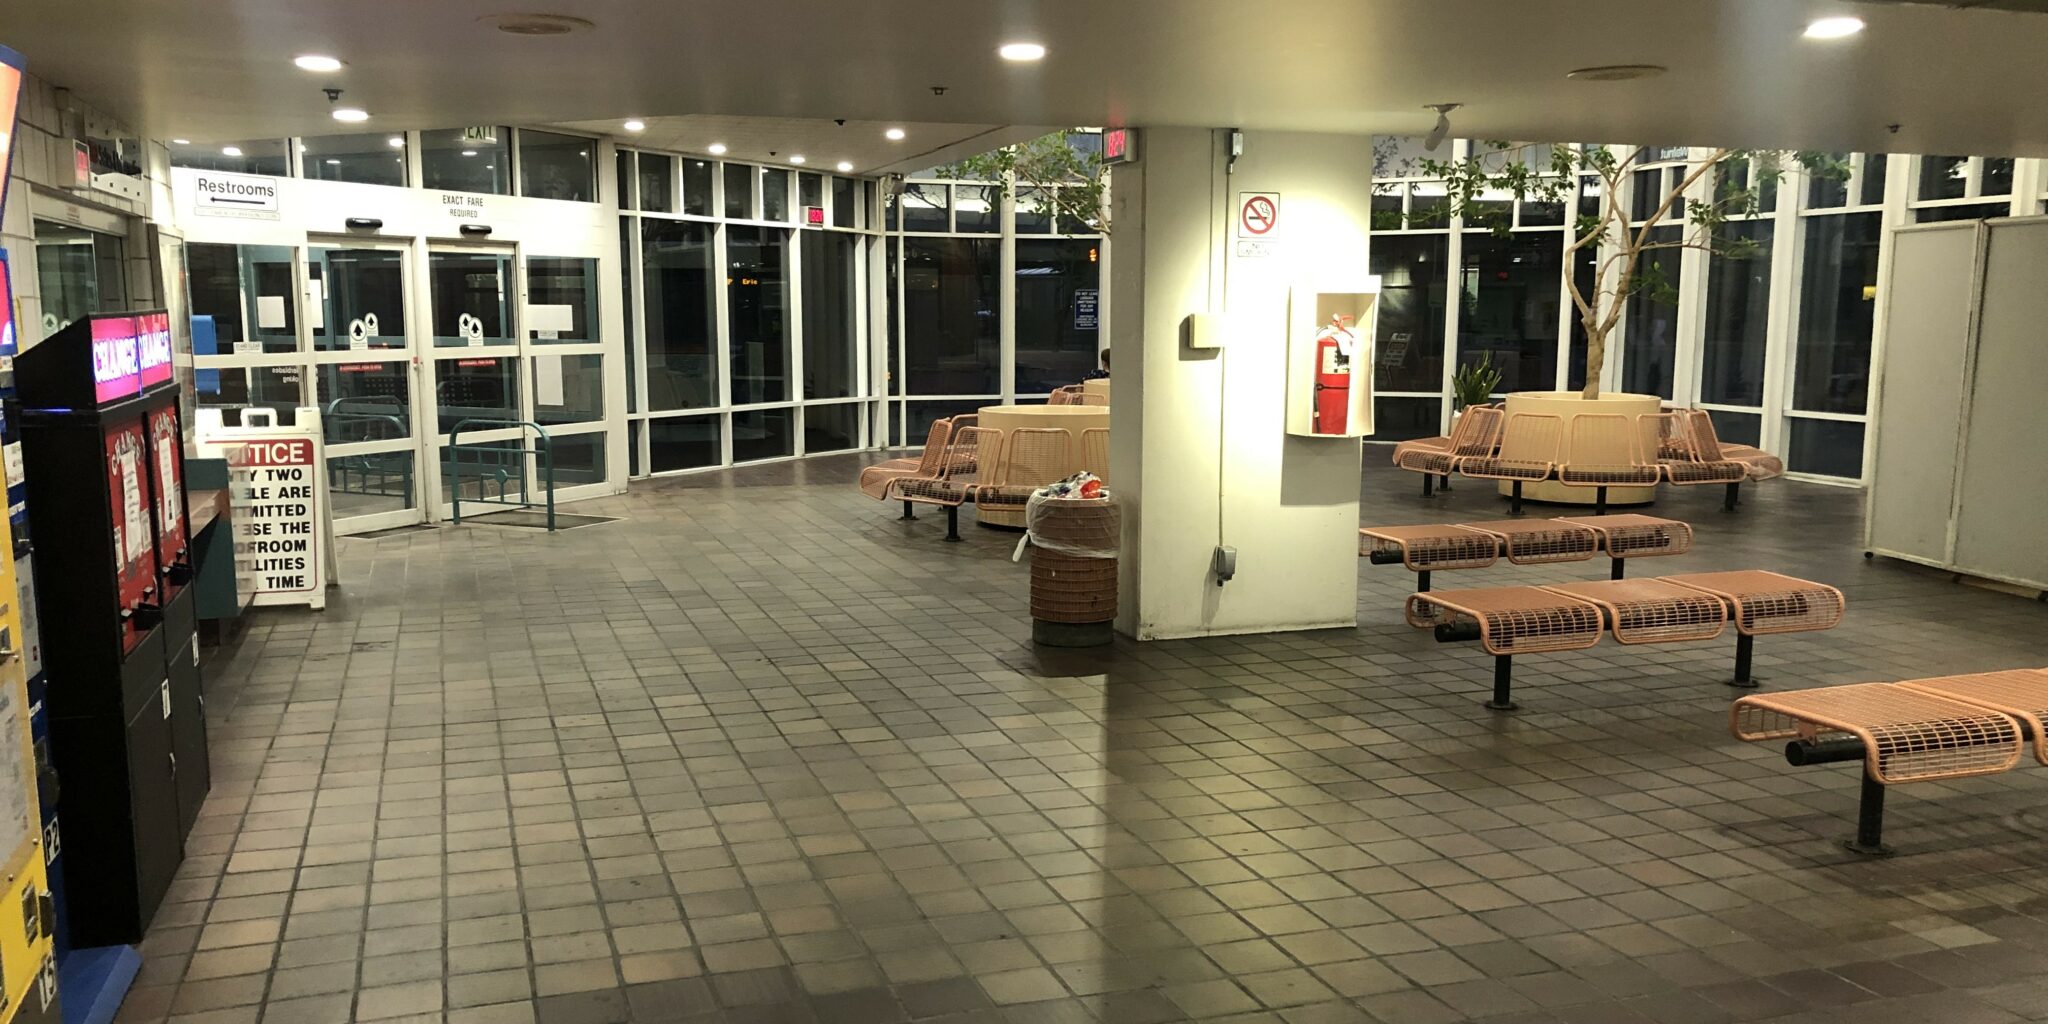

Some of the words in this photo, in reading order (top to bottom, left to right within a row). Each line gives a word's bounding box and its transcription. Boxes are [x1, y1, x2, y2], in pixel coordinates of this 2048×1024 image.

[198, 178, 274, 197] Restrooms
[442, 194, 463, 205] EXACT
[467, 196, 484, 207] FARE
[449, 208, 478, 218] REQUIRED
[249, 442, 304, 464] TICE
[265, 468, 303, 481] TWO
[278, 486, 311, 499] ARE
[280, 521, 310, 534] THE
[266, 575, 304, 588] TIME
[45, 820, 60, 864] P2
